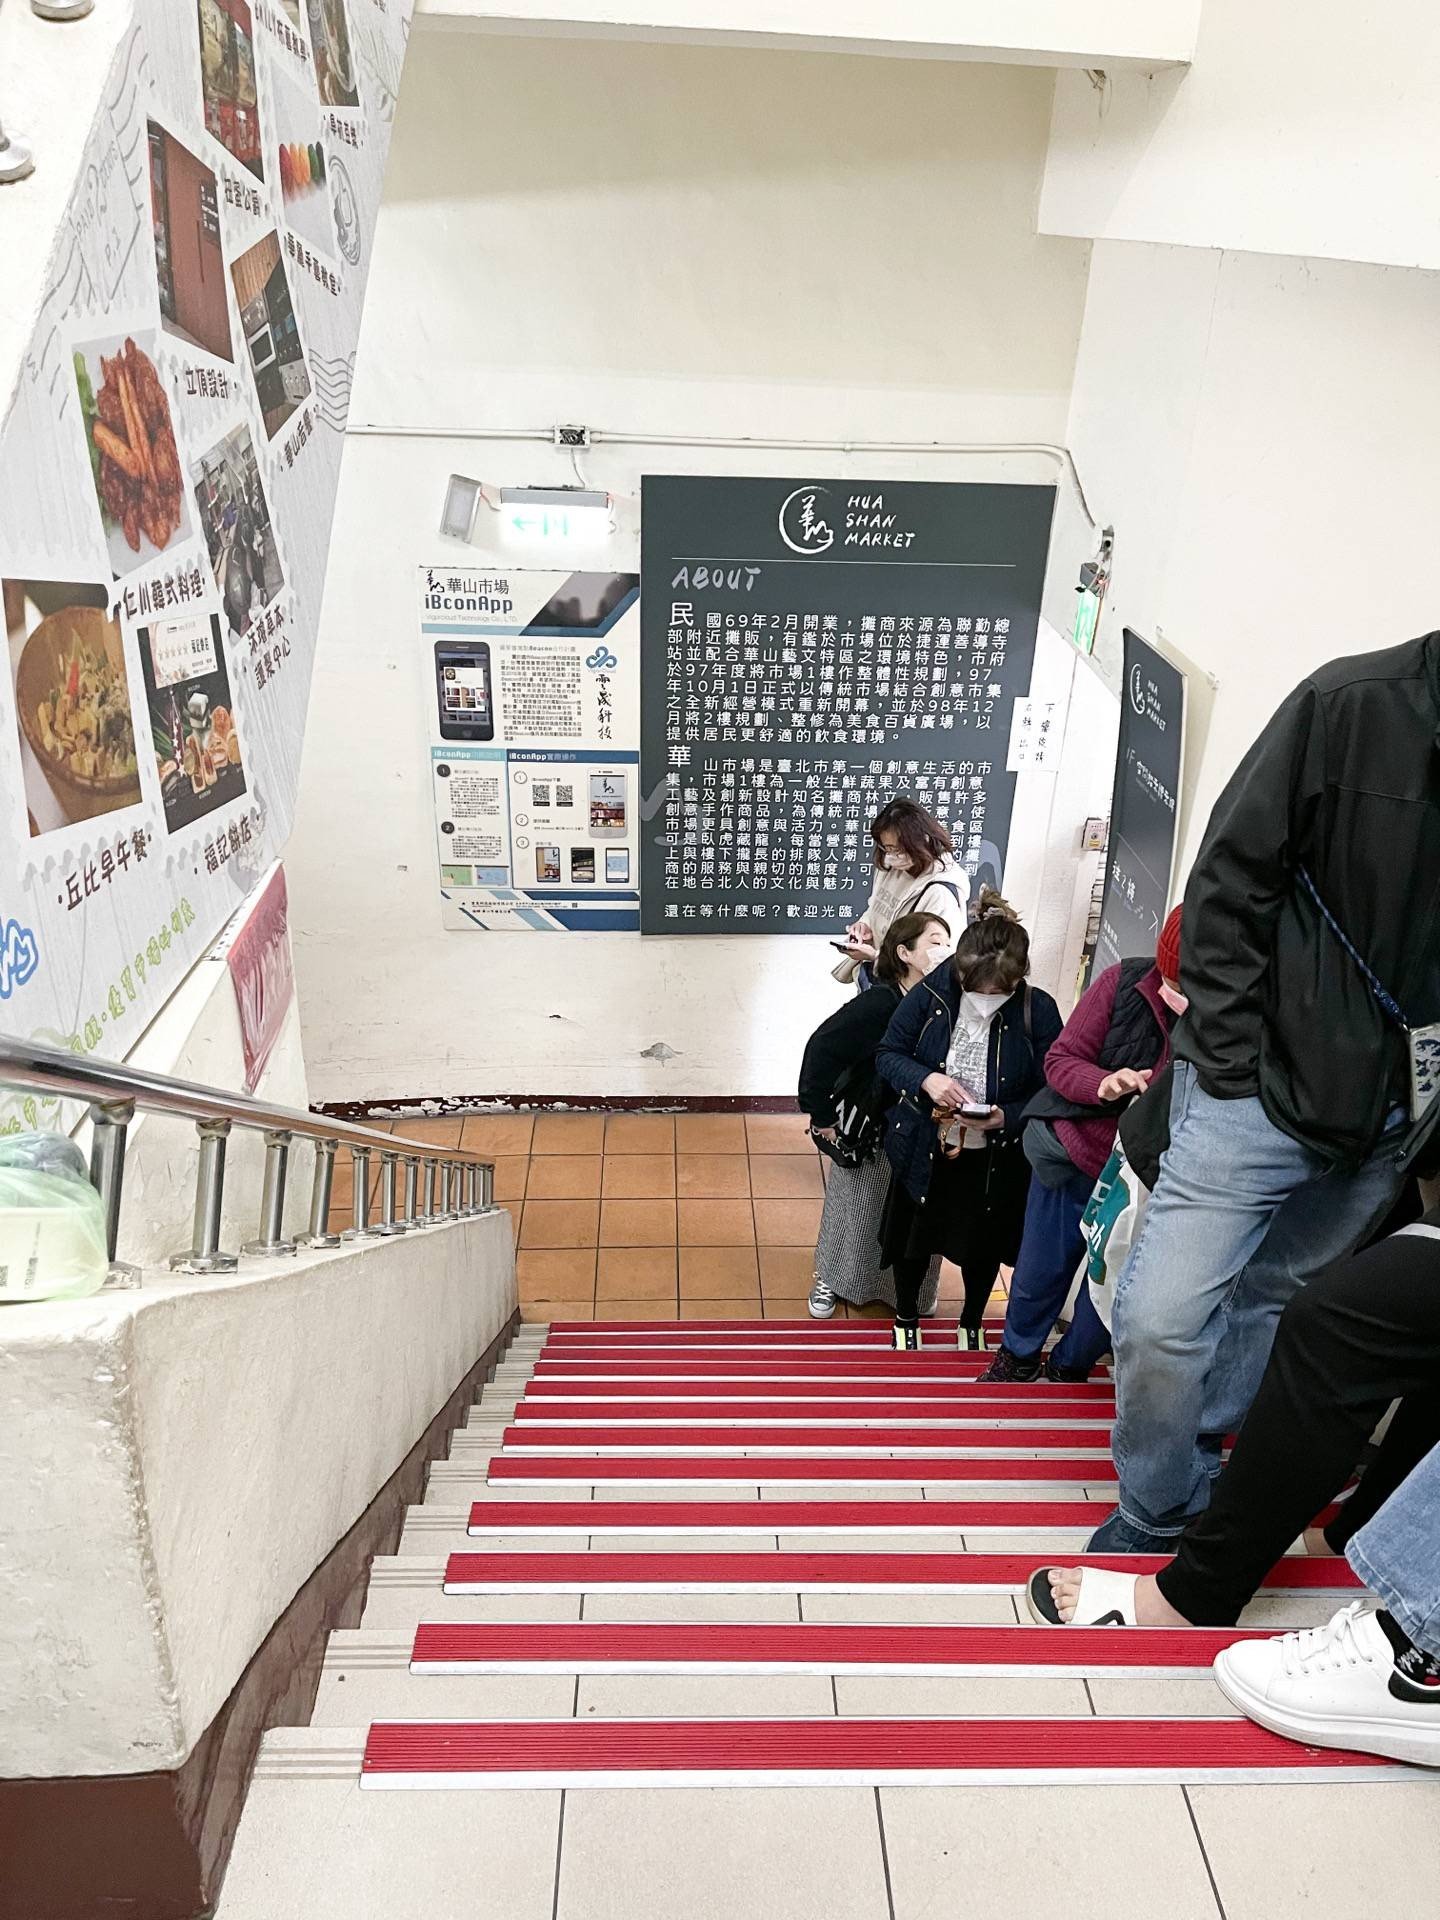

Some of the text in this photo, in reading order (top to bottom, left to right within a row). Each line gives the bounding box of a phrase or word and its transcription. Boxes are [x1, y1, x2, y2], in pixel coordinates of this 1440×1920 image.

[848, 495, 883, 510] HUA
[845, 513, 897, 529] SHAN
[844, 532, 915, 548] MARKET
[447, 578, 509, 595] 華山市場
[671, 566, 761, 591] ABOUT
[425, 594, 513, 614] iBconApp
[669, 602, 694, 627] 民
[666, 727, 900, 744] 提供居民更舒適的飲食環境。
[668, 745, 691, 768] 華
[665, 876, 869, 891] 在地台北人的文化與魅力。
